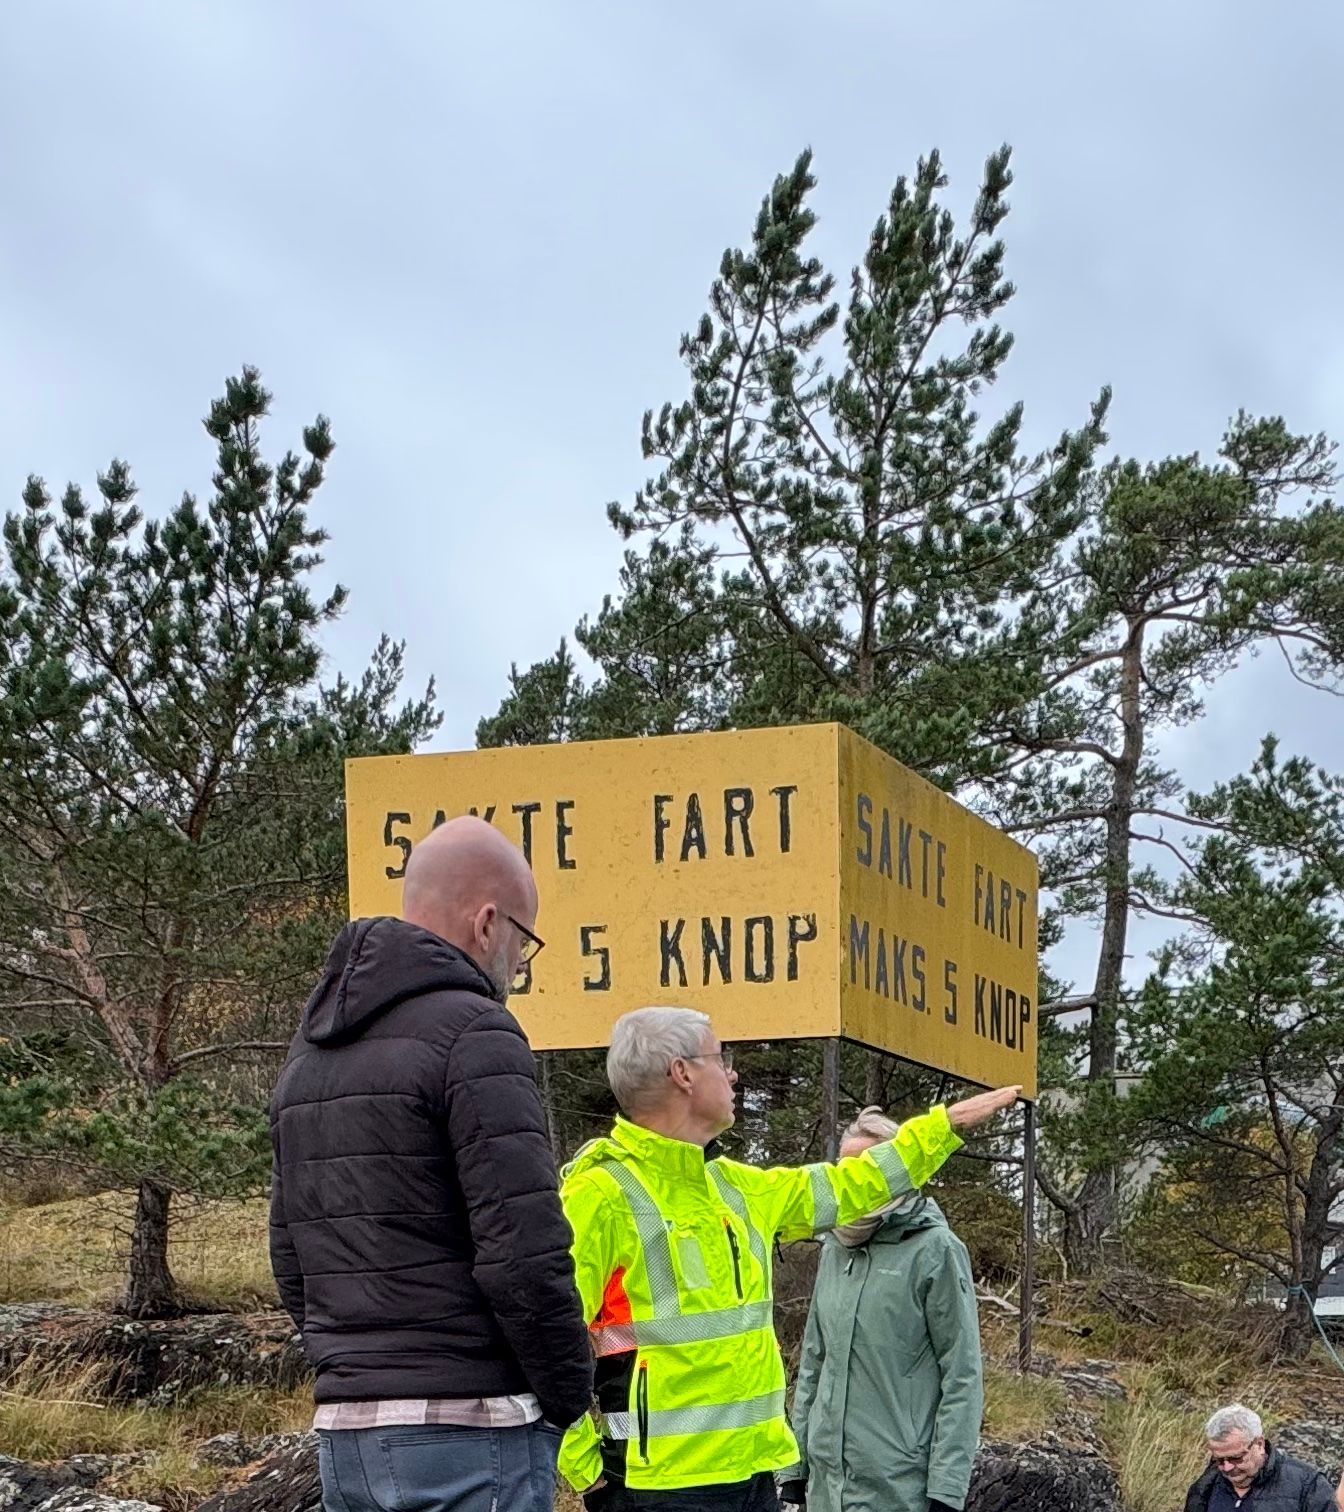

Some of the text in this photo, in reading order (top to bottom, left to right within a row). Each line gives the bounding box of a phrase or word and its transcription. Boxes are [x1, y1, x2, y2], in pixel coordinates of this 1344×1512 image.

[383, 784, 798, 880] STE FART
[856, 791, 1027, 949] SAKTE FART
[580, 925, 611, 991] 5
[659, 912, 817, 988] KNOP
[849, 913, 1031, 1053] MAKS. 5 KNOP
